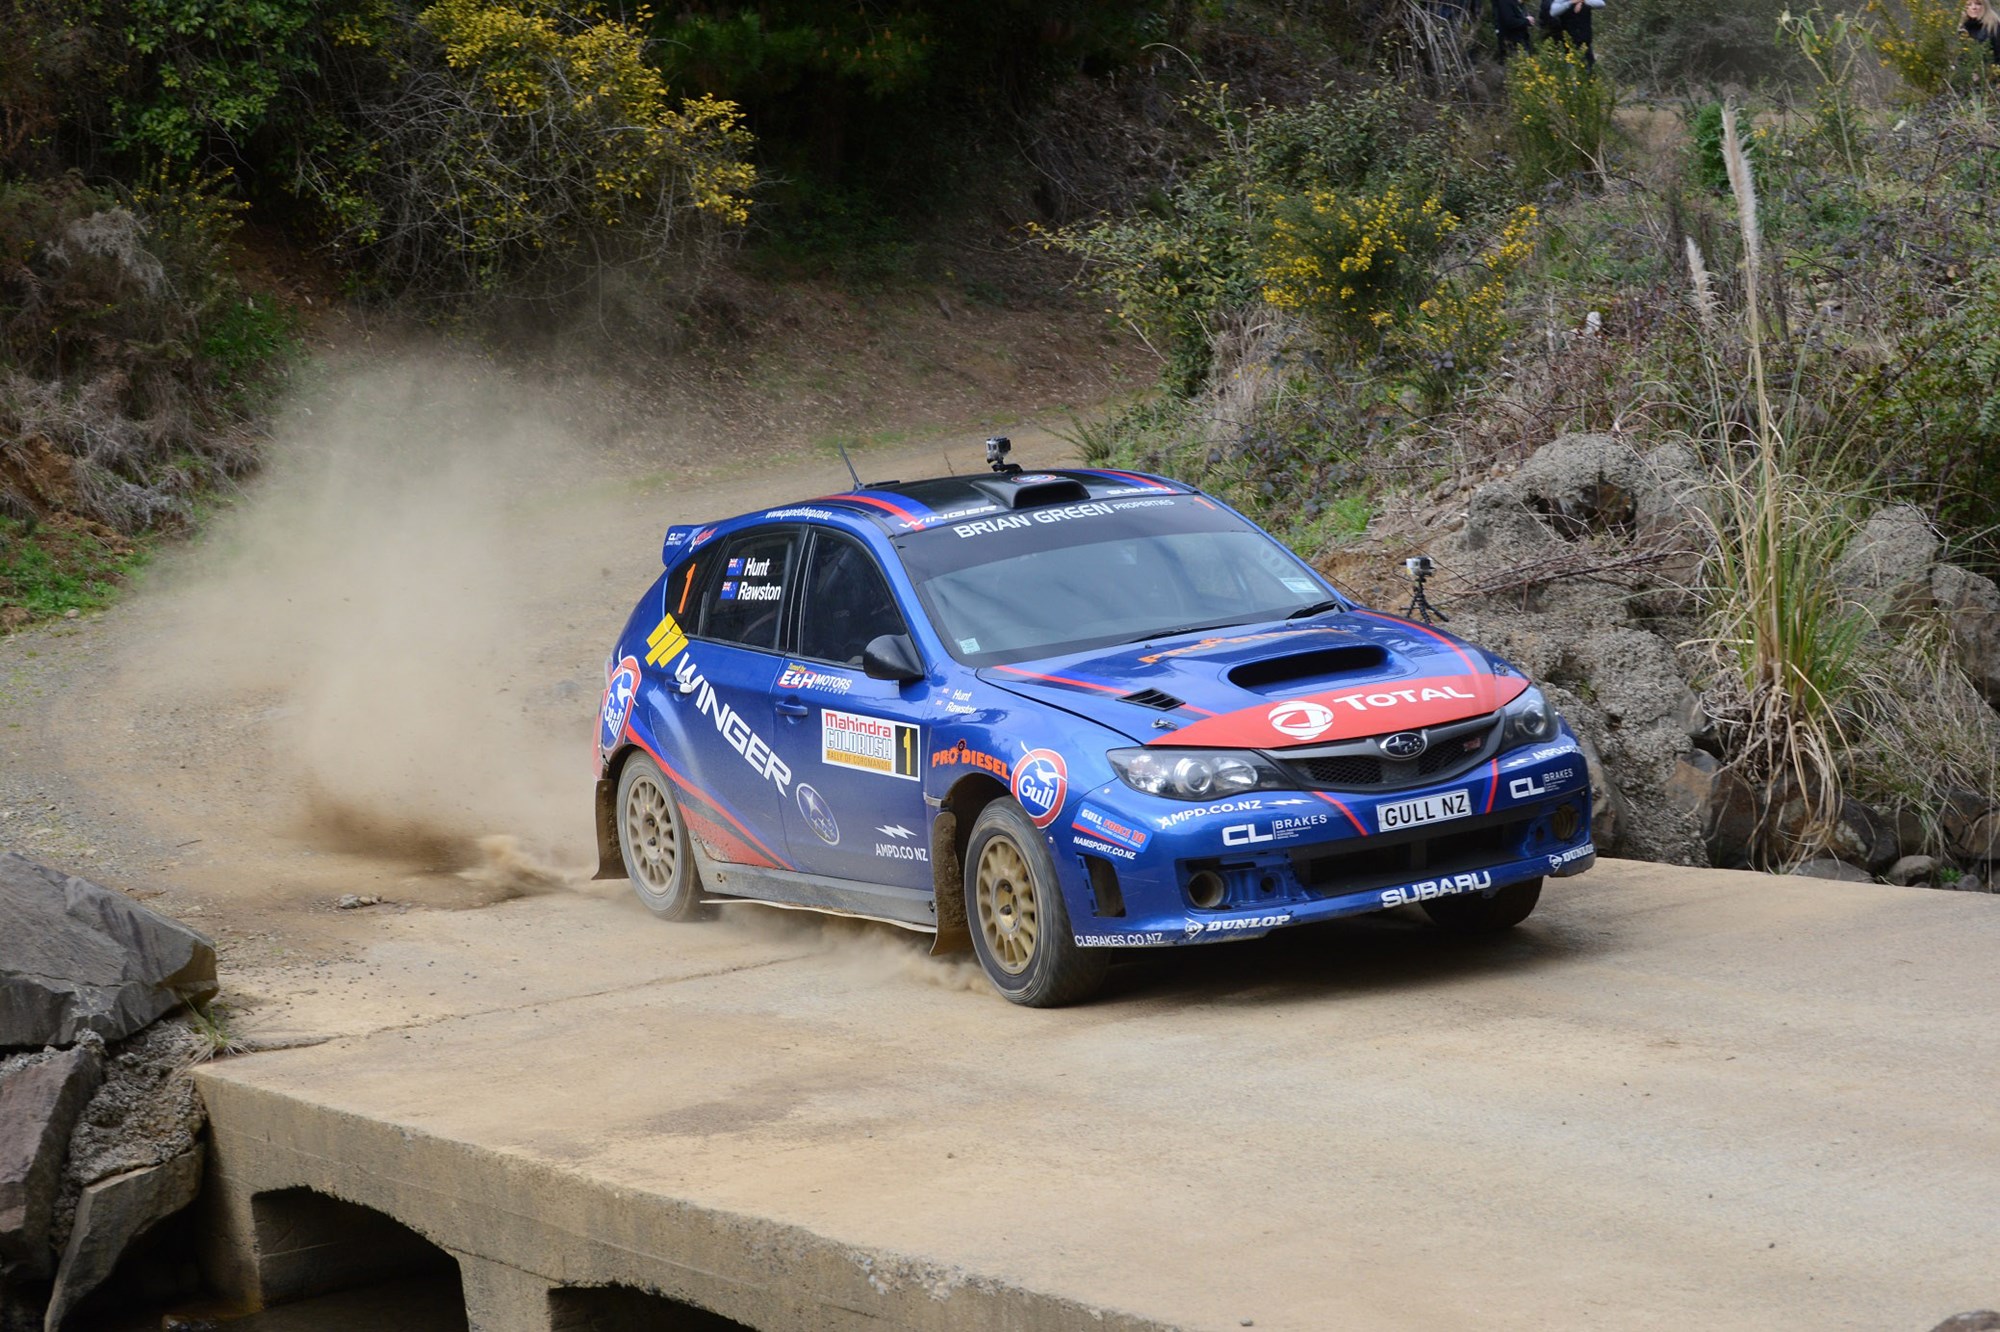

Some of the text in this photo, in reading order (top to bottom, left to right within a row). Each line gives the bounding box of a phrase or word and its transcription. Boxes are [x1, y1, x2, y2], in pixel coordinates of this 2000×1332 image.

[899, 505, 998, 528] WINGER
[952, 499, 1175, 538] BRIAN GREEN PROPERTIES
[743, 557, 771, 577] Hunt
[737, 582, 782, 600] Rawston
[779, 670, 853, 690] E&H MOTORS
[945, 701, 977, 714] Rawston
[952, 689, 973, 702] Hunt
[1333, 685, 1475, 711] TOTAL
[675, 652, 792, 798] WINGER
[825, 712, 892, 738] Mahindra
[826, 728, 892, 760] GOLDRUSH
[903, 728, 911, 775] 1
[932, 747, 1010, 780] PRO DIESEL
[1019, 775, 1055, 810] Gull
[1509, 777, 1546, 799] CL
[1544, 768, 1574, 783] BRAKES
[1156, 800, 1263, 829] AMPD.CO.NZ
[1384, 795, 1467, 827] GULL NZ
[1081, 808, 1103, 825] GULL
[1102, 818, 1132, 838] FORCE
[1131, 829, 1146, 845] 10
[1222, 823, 1273, 847] CL
[1275, 814, 1328, 829] BRAKES
[1073, 836, 1137, 860] NAMSPORT.CO.NZ
[1381, 870, 1491, 908] SUBARU
[1206, 914, 1291, 932] DUNLOP
[1074, 932, 1163, 947] CLBRAKES.CO.NZ
